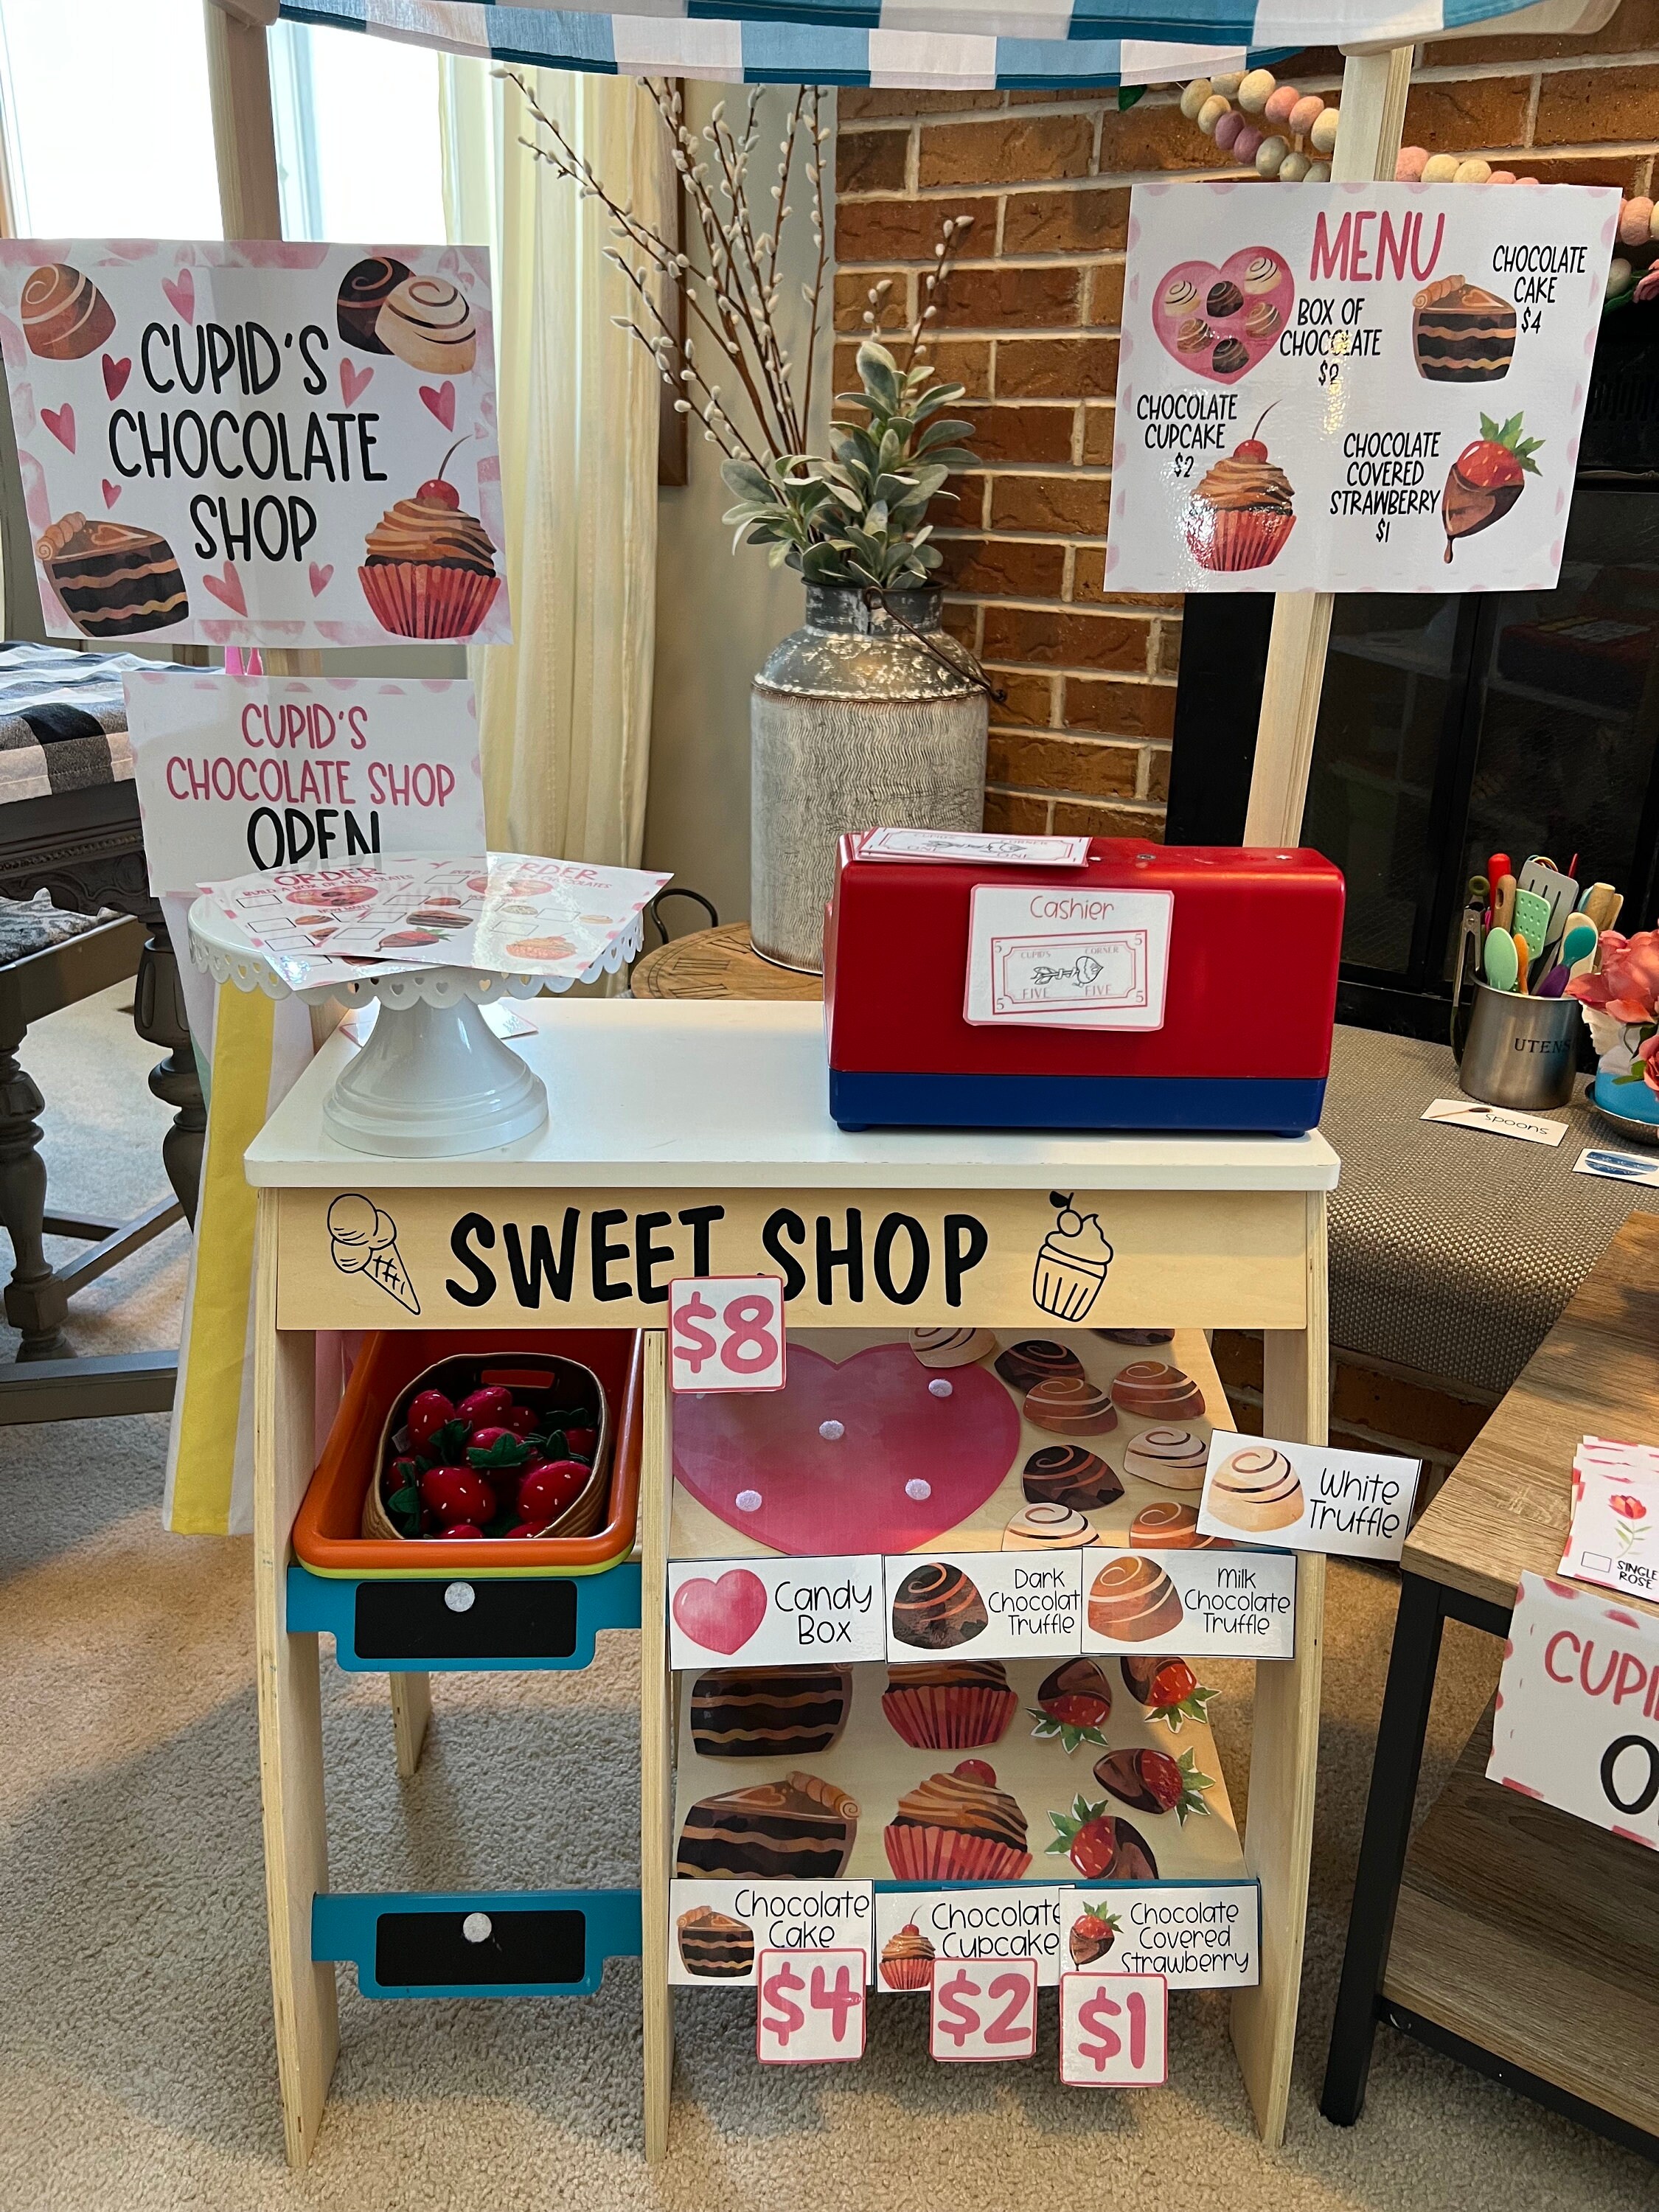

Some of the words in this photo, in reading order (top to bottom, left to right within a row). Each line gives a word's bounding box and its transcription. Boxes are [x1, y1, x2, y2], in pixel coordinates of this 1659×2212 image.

[1310, 211, 1446, 282] MENU
[1492, 244, 1589, 275] CHOCOLATE
[1514, 276, 1557, 304] CAKE
[1298, 298, 1335, 326] BOX
[1341, 298, 1366, 325] OF
[1520, 307, 1542, 334] $4
[141, 321, 330, 396] CUPID'S
[1136, 393, 1239, 422] CHOCOLATE
[108, 408, 389, 483] CHOCOLATE
[1144, 423, 1225, 451] CUPCAKE
[1343, 431, 1442, 459] CHOCOLATE
[1174, 451, 1194, 478] $2
[1346, 460, 1425, 487] COVERED
[1329, 489, 1441, 516] STRAWBERRY
[189, 494, 318, 563] SHOP
[1376, 518, 1391, 544] $1
[241, 703, 369, 751] CUPID'S
[166, 756, 355, 804] CHOCOLATE
[367, 762, 456, 807] SHOP
[247, 807, 380, 871] OPEN
[274, 867, 386, 886] ORDER
[496, 861, 599, 880] ORDER
[1029, 895, 1115, 920] Cashier
[995, 941, 1003, 953] 5
[1085, 946, 1120, 956] CORNER
[1134, 933, 1143, 946] 5
[1022, 987, 1049, 1000] FIVE
[1085, 984, 1113, 996] FIVE
[1135, 990, 1144, 1004] 5
[996, 998, 1005, 1011] 5
[1484, 1113, 1550, 1135] spoons
[445, 1205, 725, 1308] SWEET
[755, 1207, 988, 1307] SHOP
[672, 1290, 780, 1374] $8
[1320, 1467, 1400, 1505] White
[1308, 1498, 1401, 1540] Truffle
[1014, 1567, 1065, 1589] Dark
[1217, 1566, 1256, 1589] Milk
[1617, 1560, 1659, 1582] SINGLE
[1619, 1571, 1653, 1590] ROSE
[774, 1579, 873, 1613] Candy
[989, 1590, 1082, 1613] Chocolat
[1184, 1589, 1291, 1613] Chocolate
[797, 1614, 853, 1646] Box
[1008, 1613, 1076, 1636] Truffle
[1202, 1613, 1271, 1636] Truffle
[1545, 1630, 1659, 1721] CUPI
[735, 1889, 870, 1918] Chocolate
[1130, 1902, 1239, 1926] Chocolate
[768, 1920, 835, 1949] Cake
[942, 1930, 1060, 1958] Cupcake
[1138, 1925, 1231, 1949] Covered
[1121, 1950, 1250, 1973] Strawberry
[762, 1961, 865, 2046] $4
[936, 1968, 1032, 2048] $2
[1078, 1986, 1147, 2072] $1
